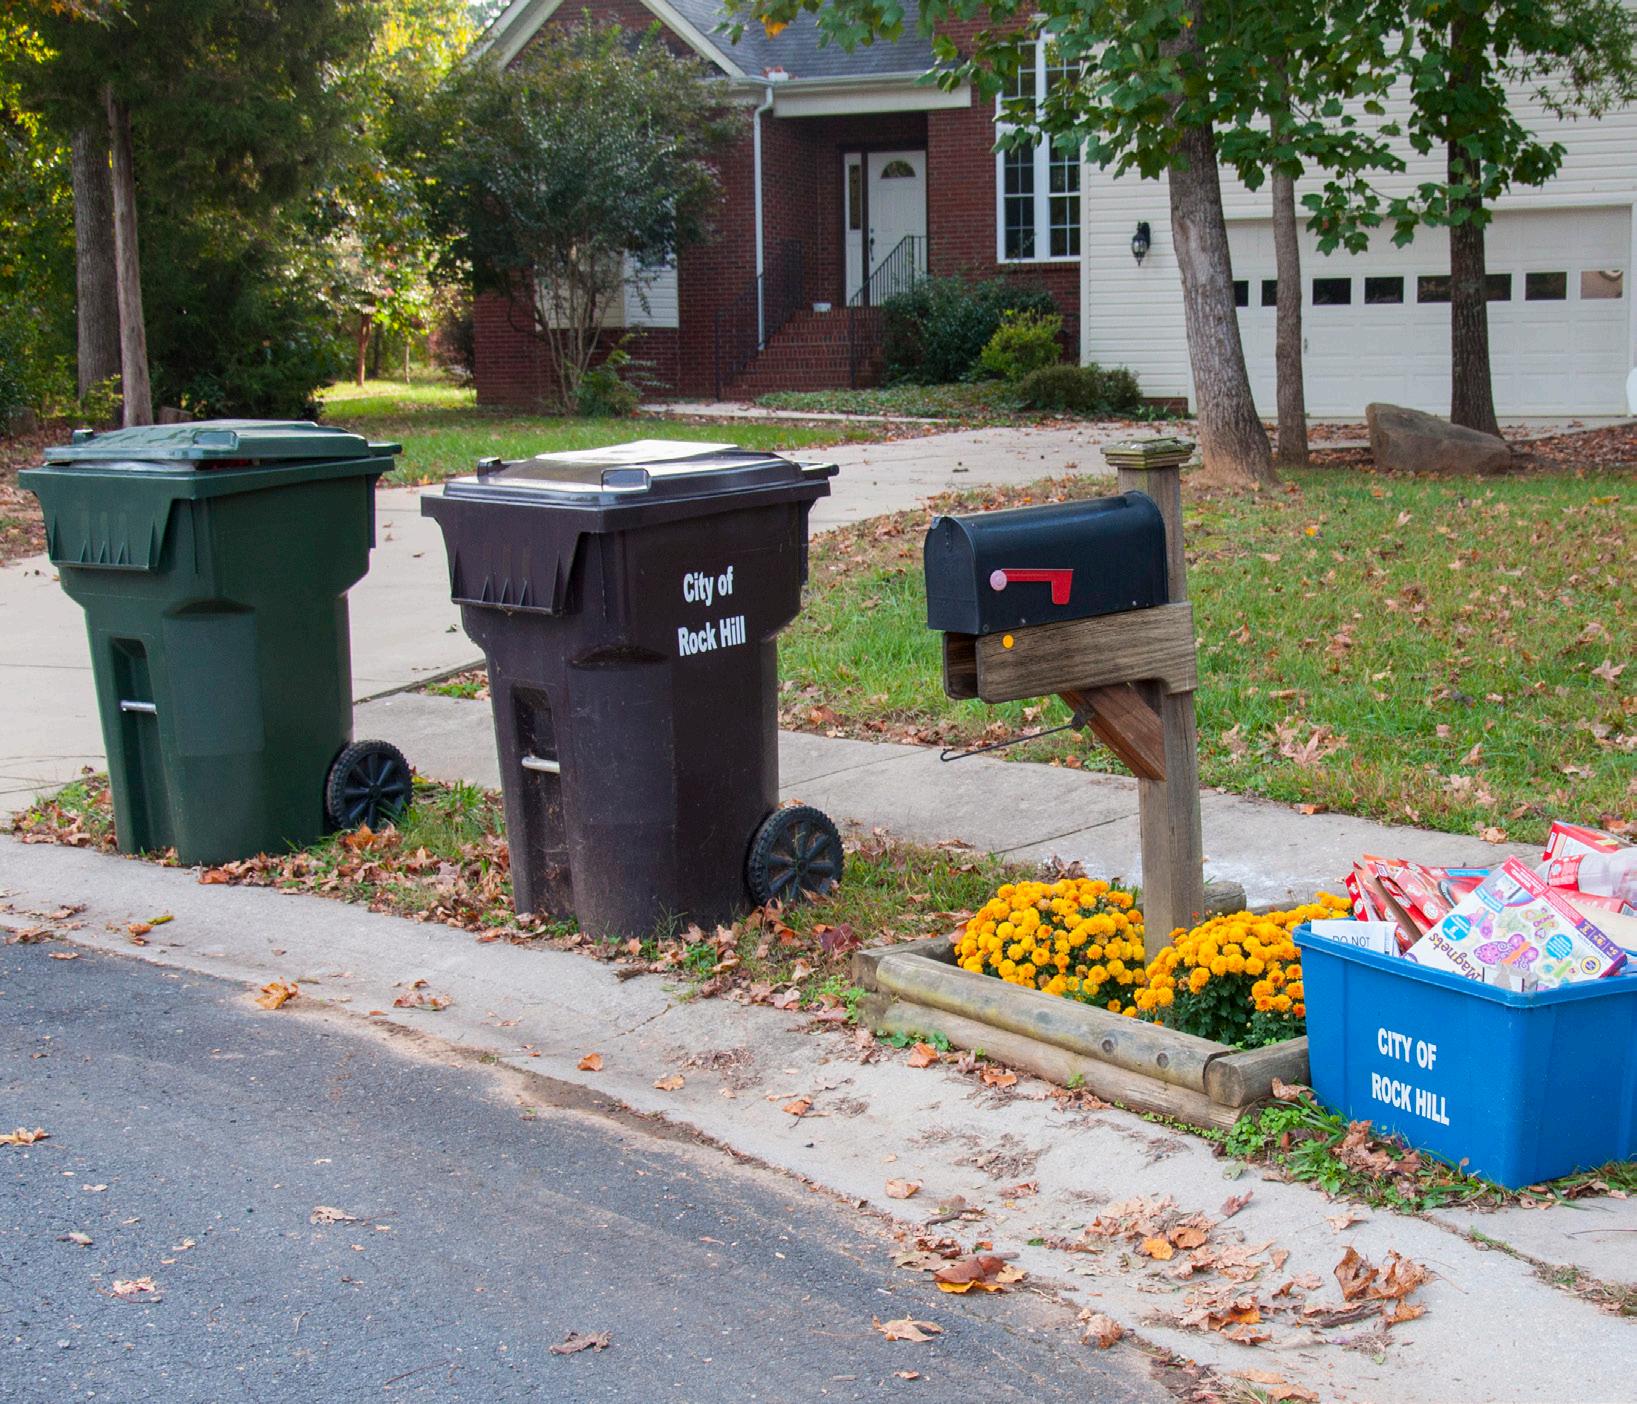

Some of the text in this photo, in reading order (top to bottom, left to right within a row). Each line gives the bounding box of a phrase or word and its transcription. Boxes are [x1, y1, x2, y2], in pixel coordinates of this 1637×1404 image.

[683, 565, 734, 607] City of
[678, 615, 747, 657] Rock Hill
[1428, 932, 1481, 981] Magnets
[1377, 1027, 1437, 1071] CITY OF
[1371, 1071, 1450, 1127] ROCK HILL
